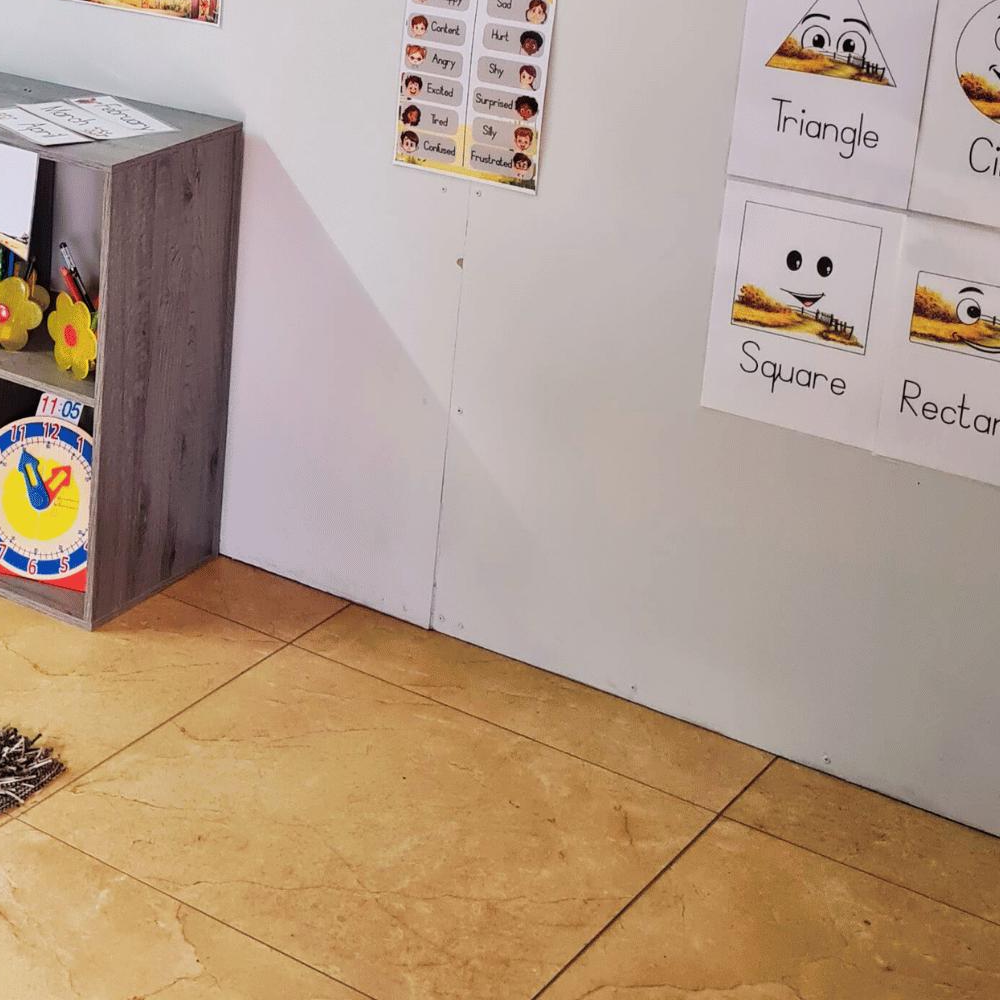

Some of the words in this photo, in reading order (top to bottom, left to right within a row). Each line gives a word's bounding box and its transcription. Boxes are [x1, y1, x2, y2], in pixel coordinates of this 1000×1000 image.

[430, 21, 461, 37] Content
[490, 28, 510, 43] Hurt
[431, 53, 457, 71] Angry
[488, 63, 505, 78] Shy
[426, 82, 455, 99] Excited
[475, 92, 514, 111] Surprised
[44, 104, 90, 127] March
[430, 113, 449, 128] Tired
[482, 125, 498, 140] Silly
[770, 96, 880, 160] Triangle
[423, 140, 457, 158] Confused
[470, 150, 514, 170] Frustrated
[738, 340, 848, 394] Square
[41, 395, 82, 419] 11:05
[10, 424, 27, 442] 11
[43, 422, 61, 440] 12
[77, 436, 84, 454] 1
[0, 543, 8, 559] 7
[27, 558, 37, 575] 6
[59, 557, 69, 573] 5
